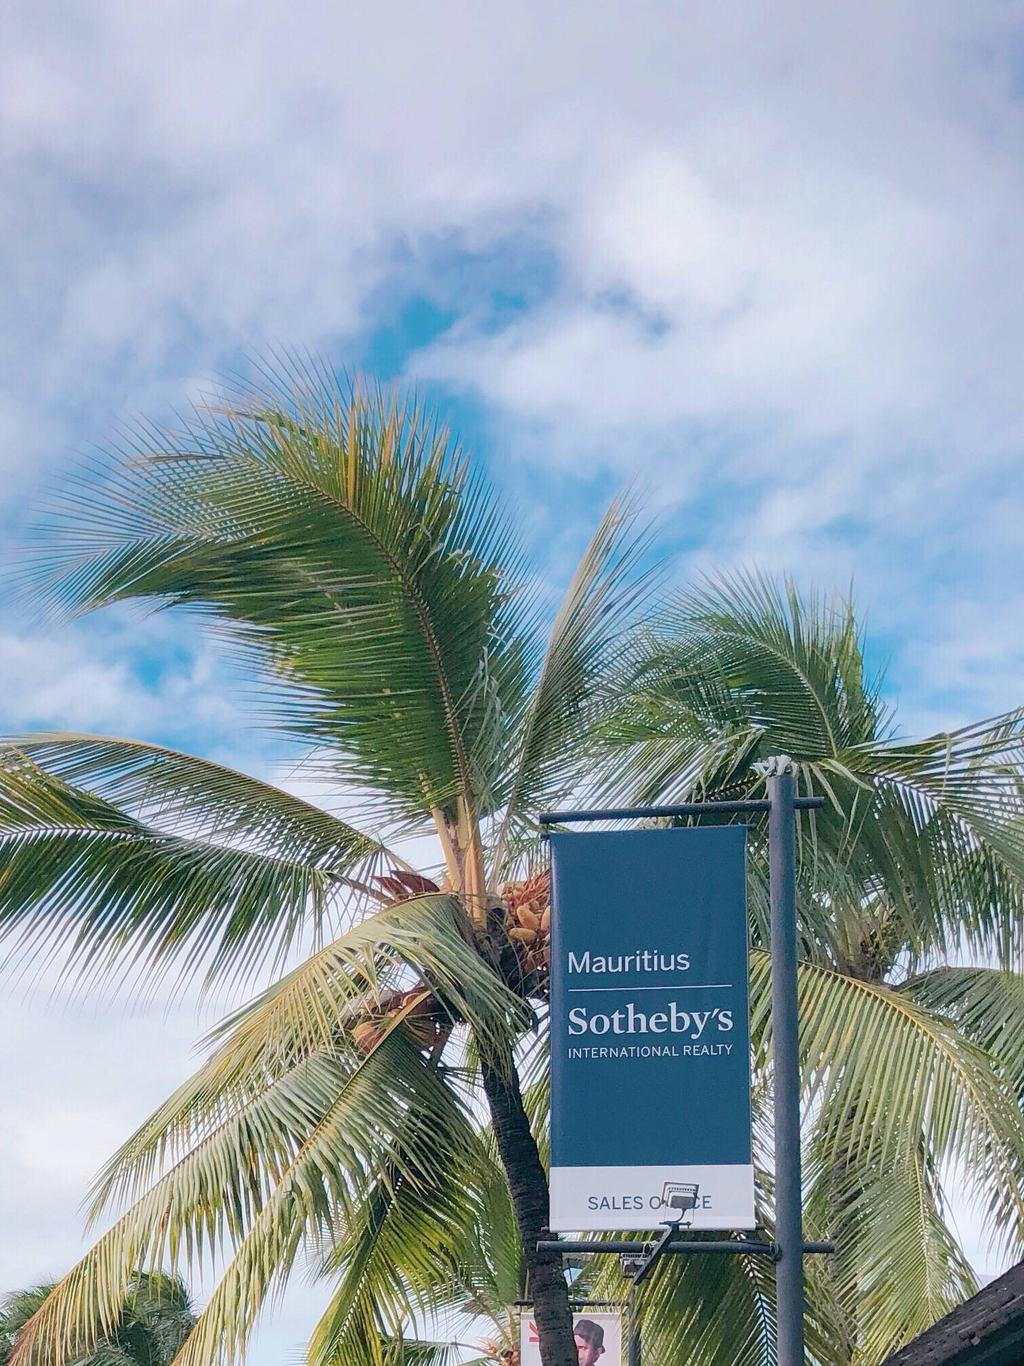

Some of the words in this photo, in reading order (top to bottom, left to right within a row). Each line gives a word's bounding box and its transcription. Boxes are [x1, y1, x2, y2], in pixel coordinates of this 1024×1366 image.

[568, 950, 690, 974] Mauritius
[568, 1002, 734, 1040] Sotheby's
[568, 1046, 679, 1059] INTERNATIONAL
[683, 1043, 733, 1056] REALTY
[588, 1196, 643, 1210] SALES
